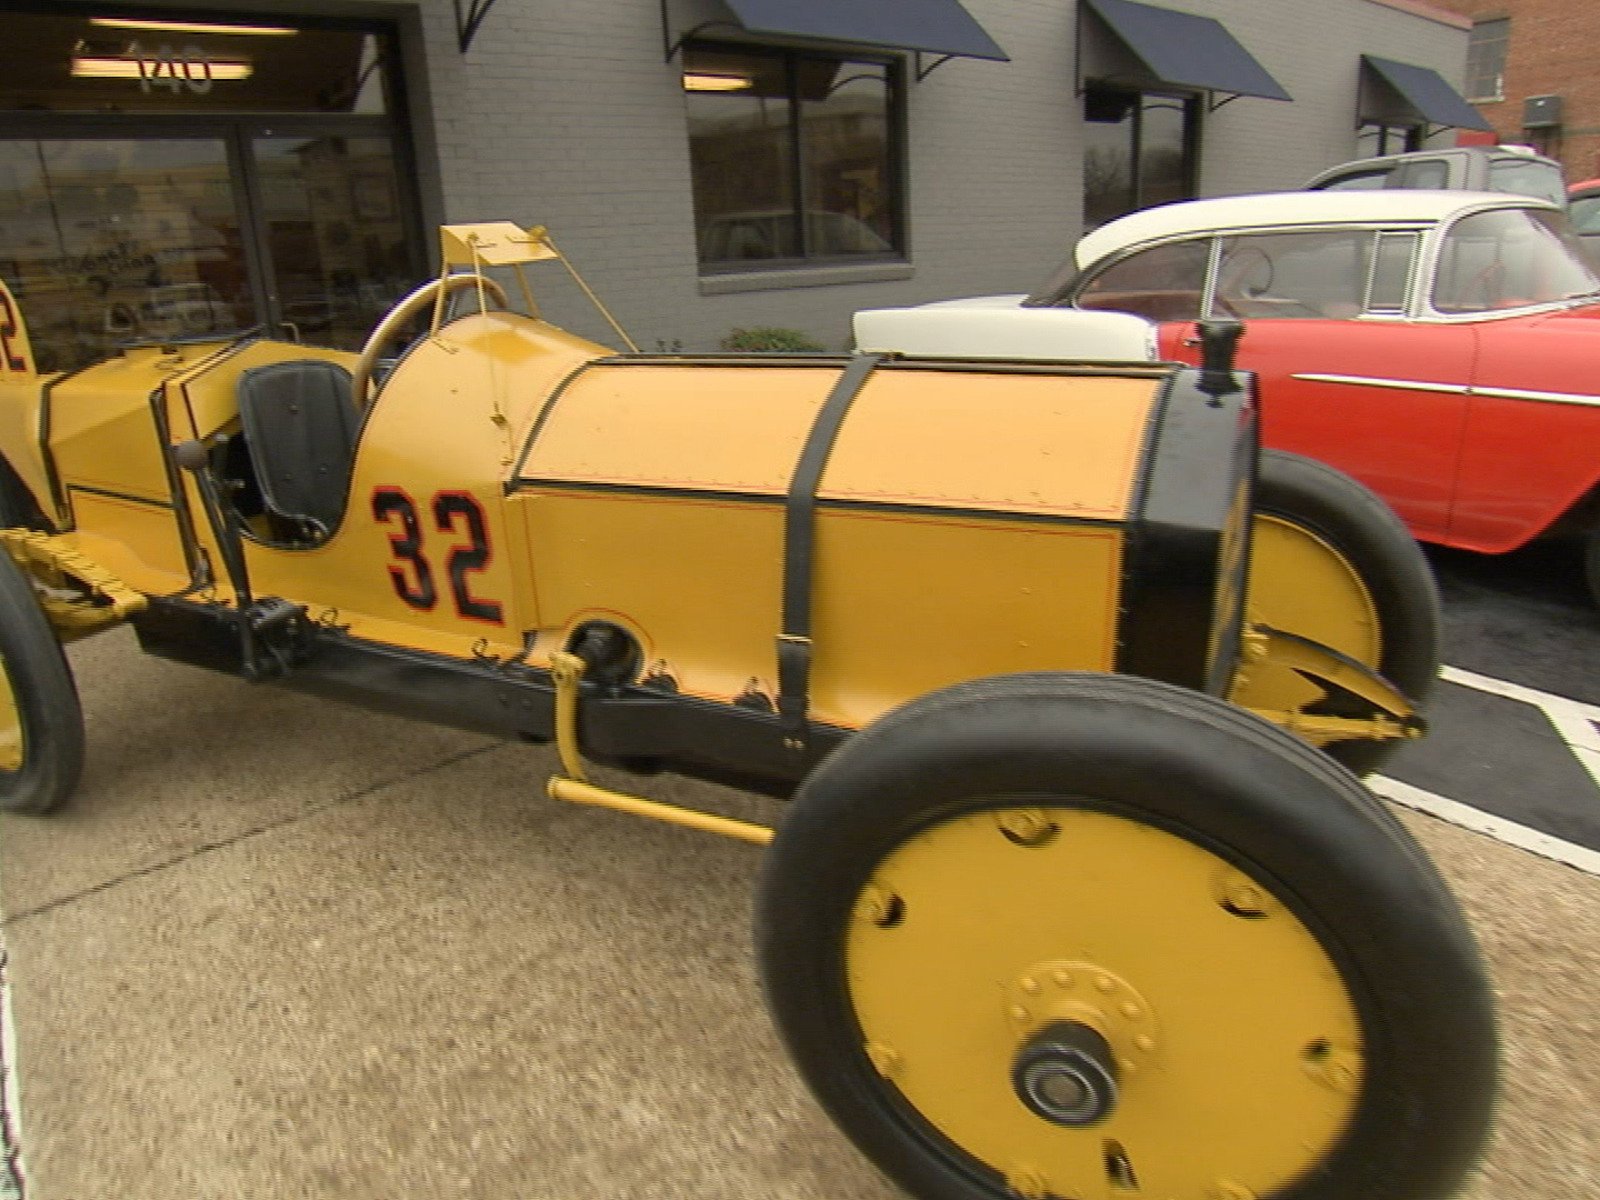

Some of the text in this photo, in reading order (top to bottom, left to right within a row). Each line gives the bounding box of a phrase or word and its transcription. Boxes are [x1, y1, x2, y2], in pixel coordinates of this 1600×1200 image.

[133, 45, 213, 94] 140
[0, 289, 27, 372] 2
[371, 485, 505, 626] 32
